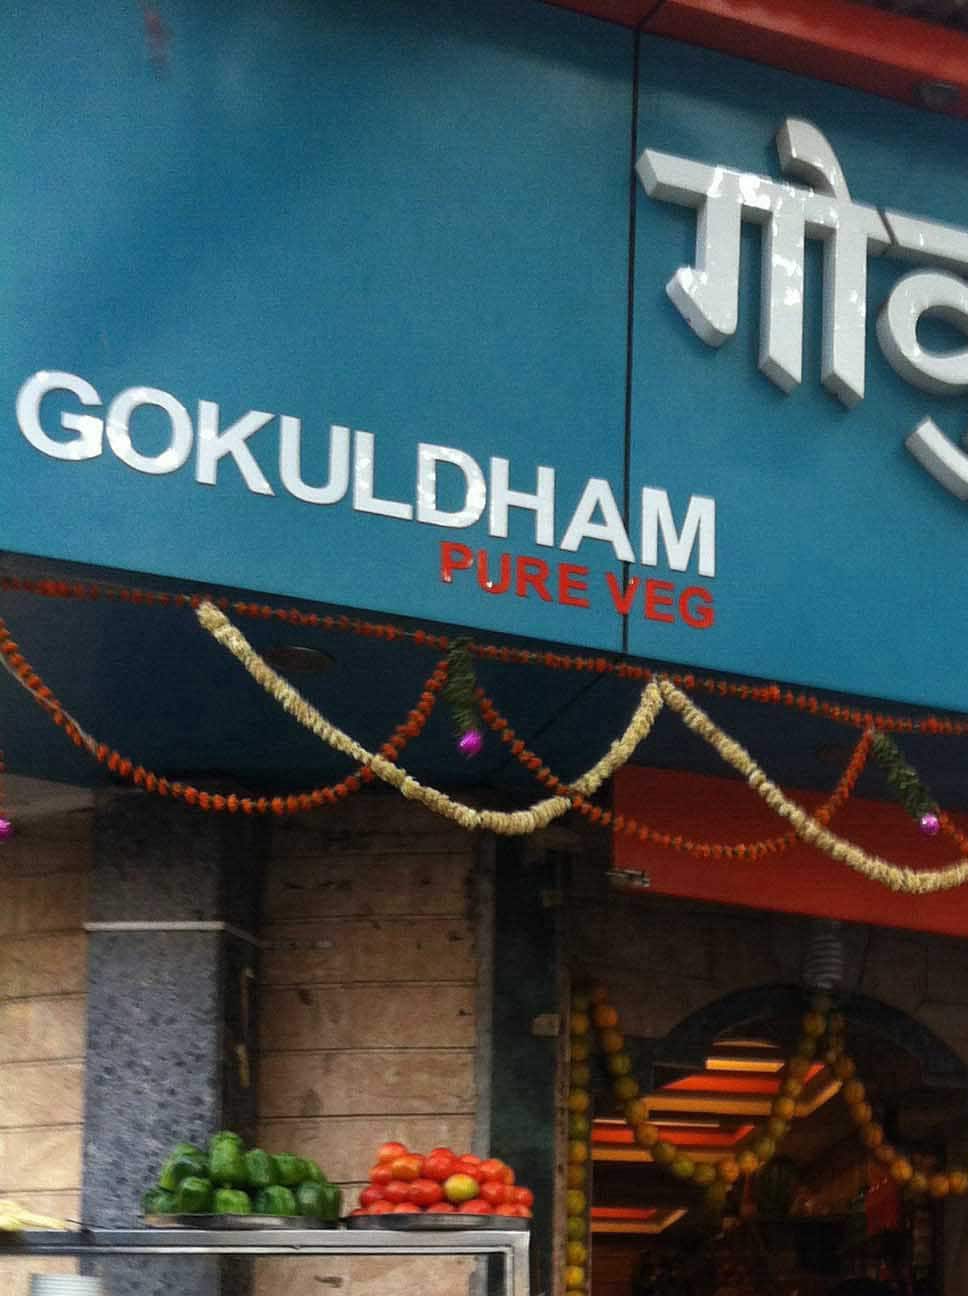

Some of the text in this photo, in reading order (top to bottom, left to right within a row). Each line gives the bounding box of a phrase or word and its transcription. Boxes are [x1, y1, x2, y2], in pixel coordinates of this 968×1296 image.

[15, 369, 716, 577] GOKULDHAM
[439, 541, 715, 629] PURE VEG
